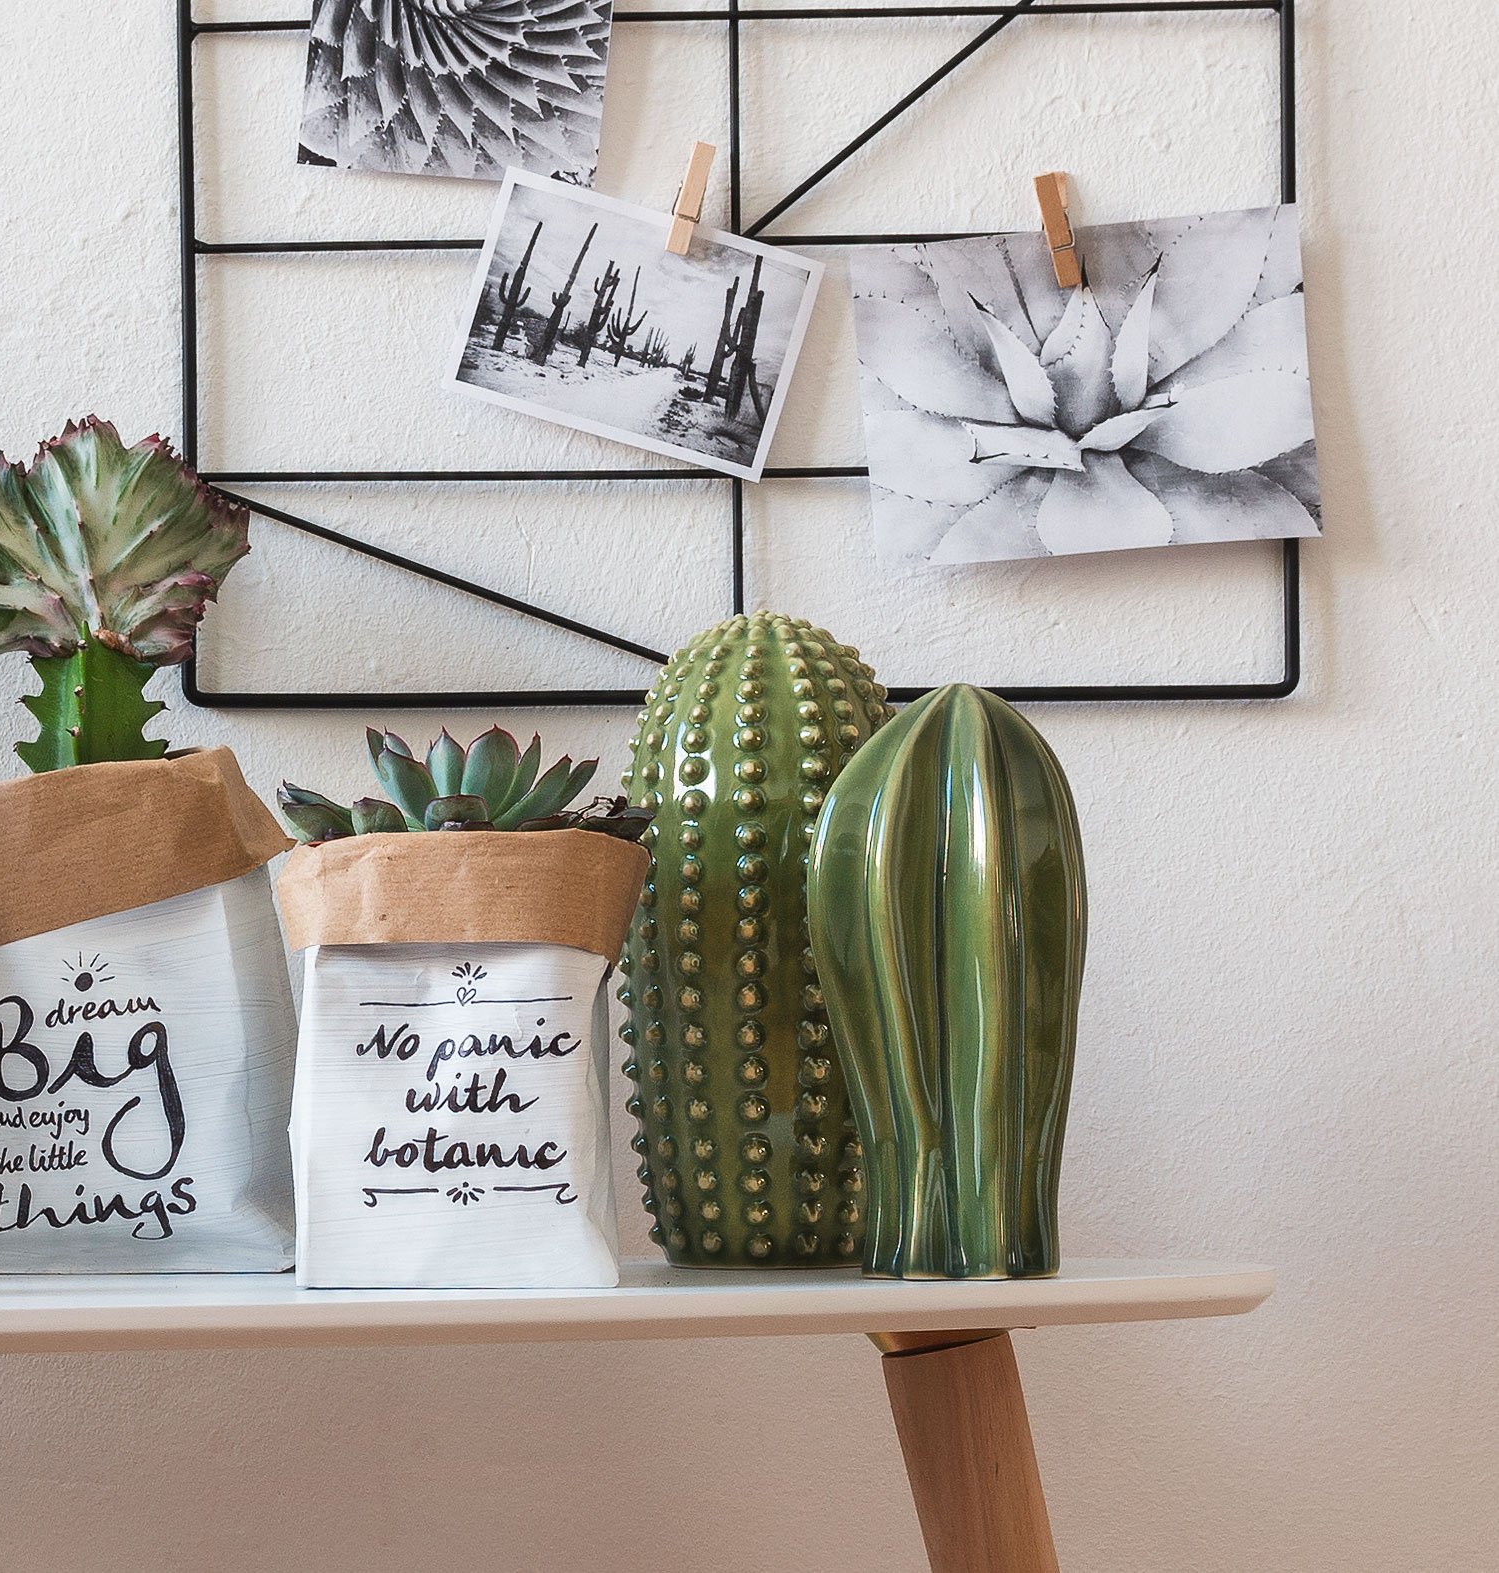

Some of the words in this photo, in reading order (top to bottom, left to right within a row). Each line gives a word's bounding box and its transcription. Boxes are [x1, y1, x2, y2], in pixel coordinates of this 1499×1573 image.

[45, 996, 161, 1027] dream
[356, 1023, 420, 1060] No
[426, 1018, 582, 1081] panic
[405, 1067, 539, 1113] with
[29, 1101, 90, 1139] enjoy
[28, 1140, 89, 1172] little
[364, 1127, 568, 1173] botanic
